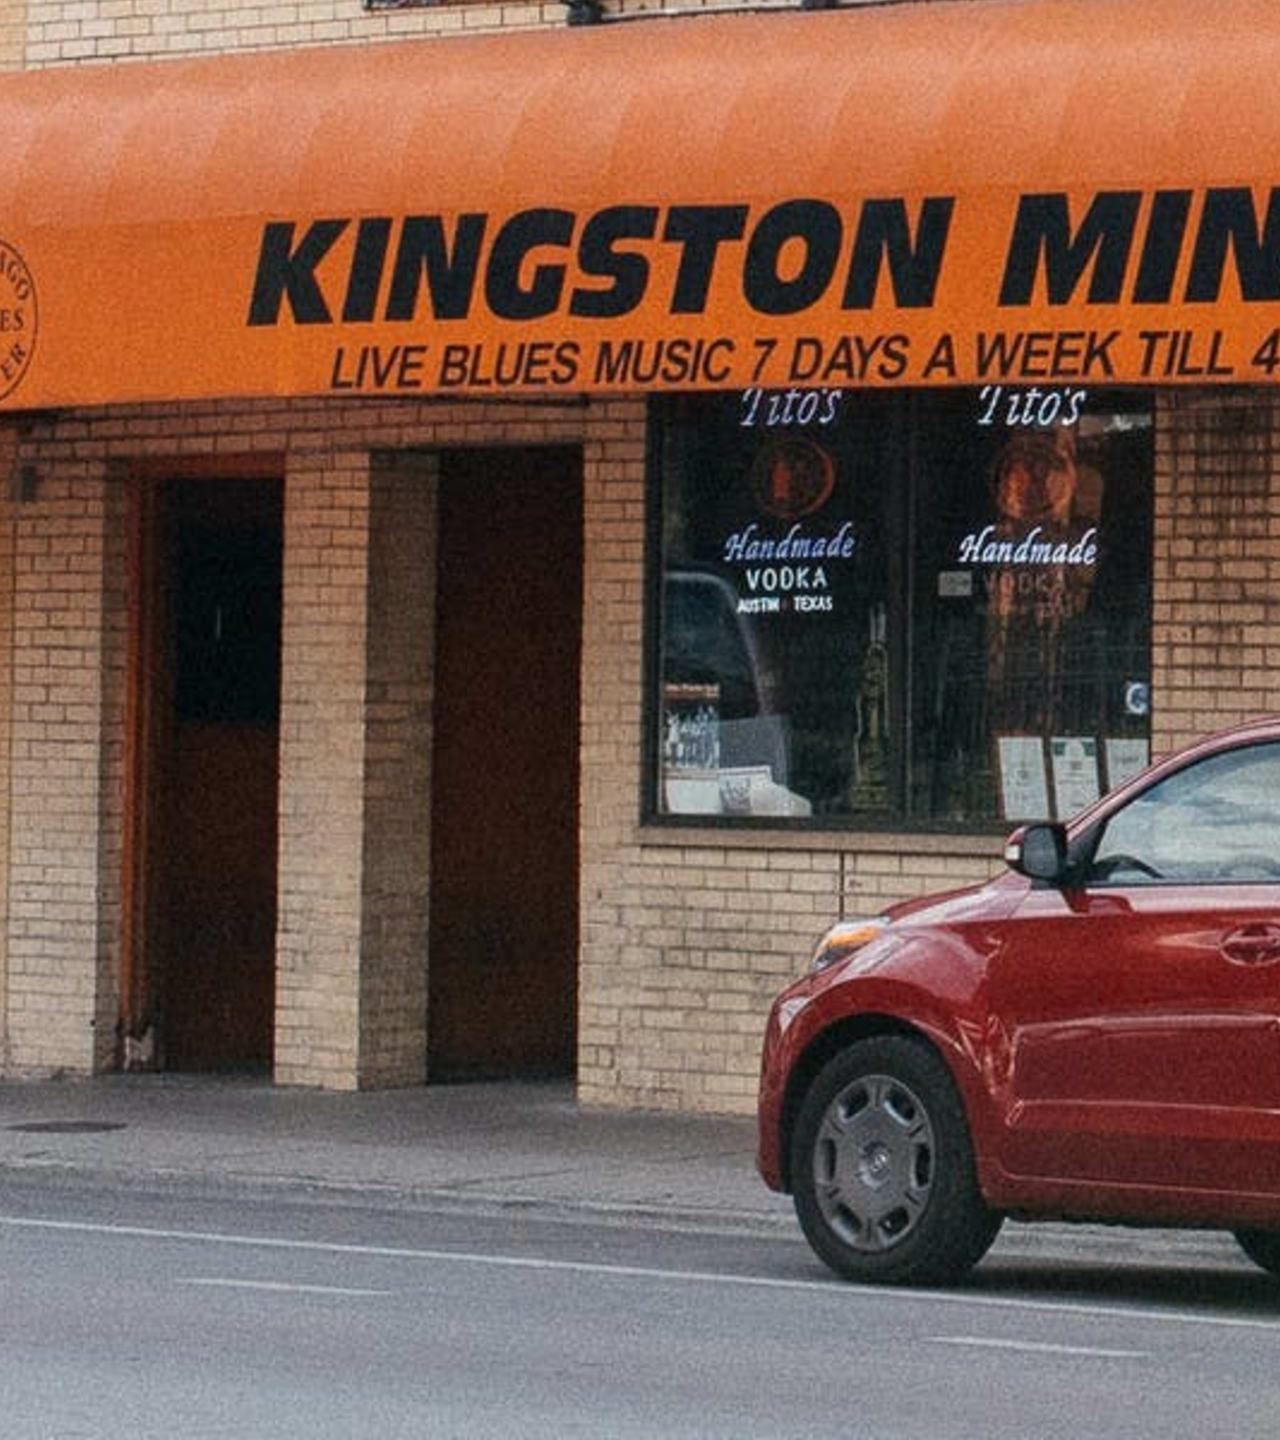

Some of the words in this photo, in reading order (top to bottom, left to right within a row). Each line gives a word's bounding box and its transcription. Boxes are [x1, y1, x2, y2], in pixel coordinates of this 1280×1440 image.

[246, 195, 956, 326] KINGSTON
[331, 344, 427, 390] LIVE
[437, 341, 580, 387] BLUES
[594, 338, 737, 385] MUSIC
[753, 338, 777, 382] 7
[787, 334, 910, 381] DAYS
[922, 334, 958, 378] A
[975, 330, 1121, 378] WEEK
[1138, 329, 1234, 375] TILL
[724, 521, 855, 562] Handmade
[959, 526, 1097, 566] Handmade
[746, 566, 828, 591] VODKA
[737, 595, 780, 614] AUSTIN
[794, 595, 833, 612] TEXAS
